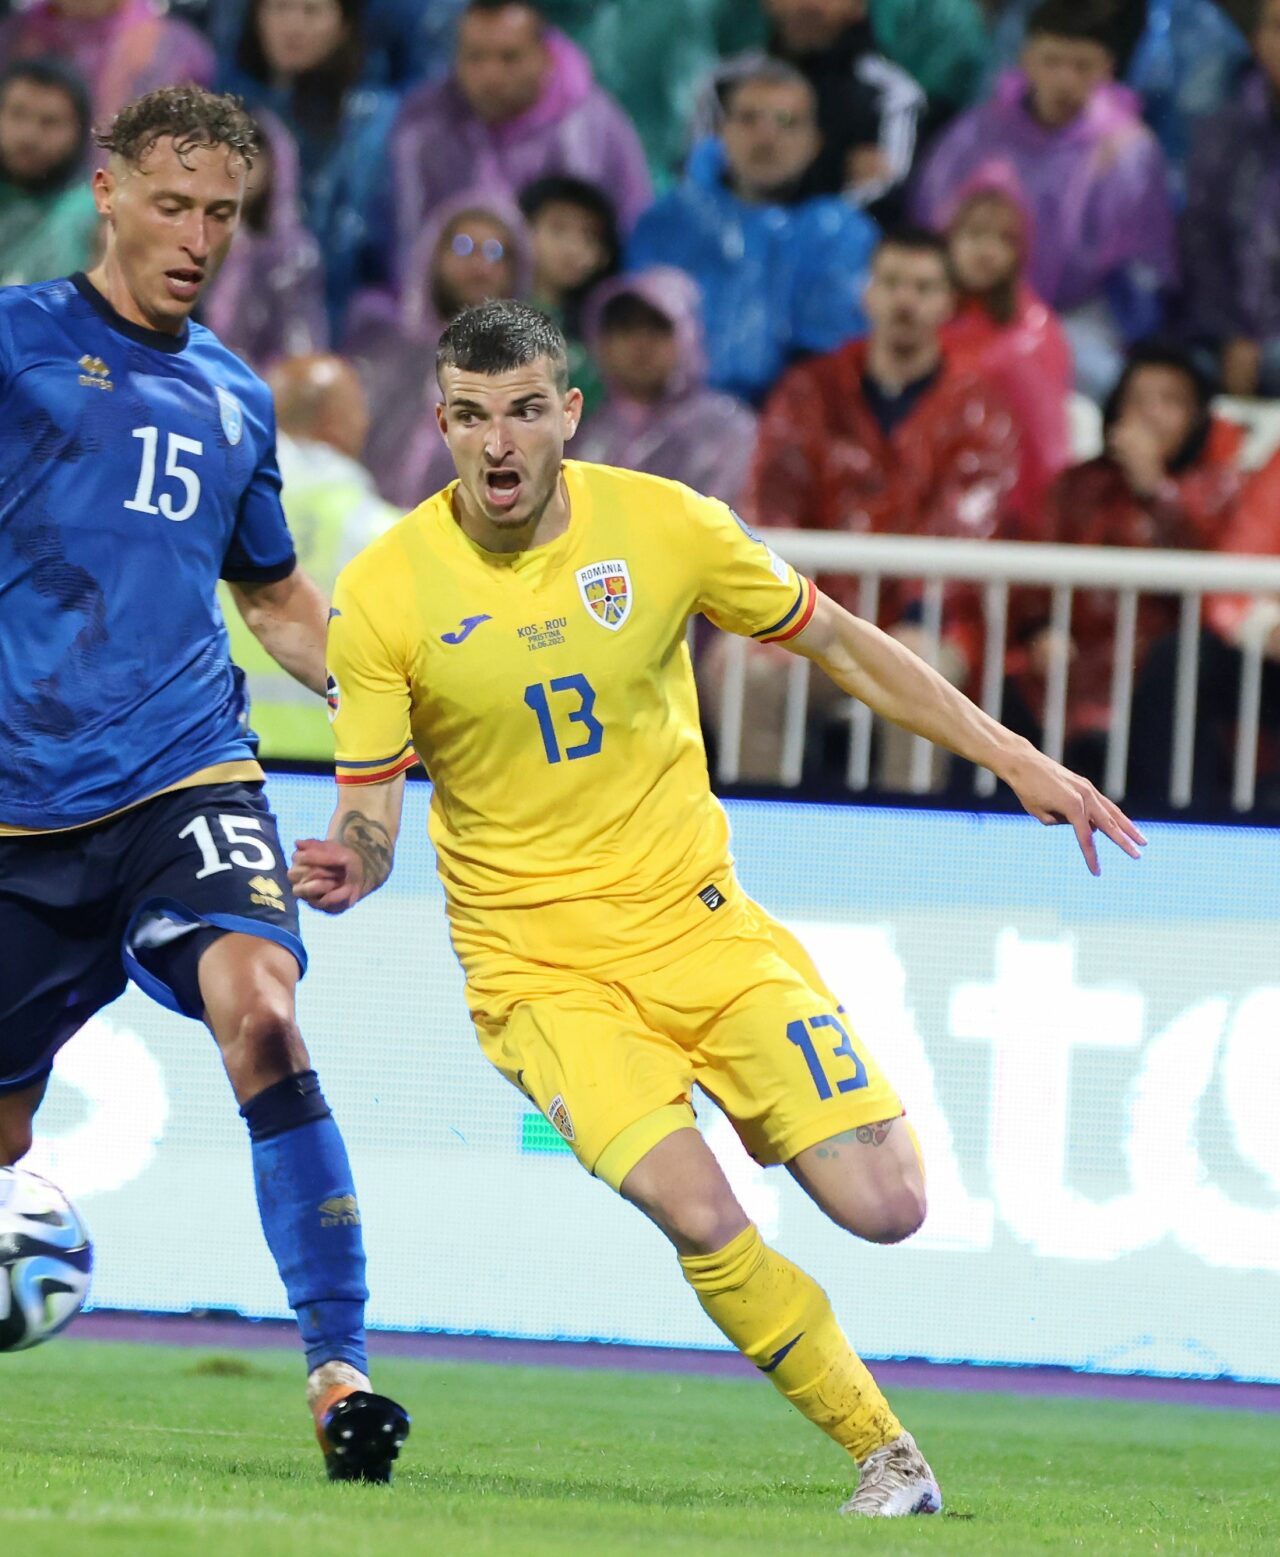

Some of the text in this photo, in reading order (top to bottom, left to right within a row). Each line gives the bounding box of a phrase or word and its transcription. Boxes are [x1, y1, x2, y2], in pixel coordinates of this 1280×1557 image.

[123, 426, 203, 521] 15
[516, 624, 538, 638] KOS
[545, 617, 567, 629] ROU
[524, 673, 604, 764] 13
[178, 813, 276, 880] 15
[786, 1014, 869, 1101] 13
